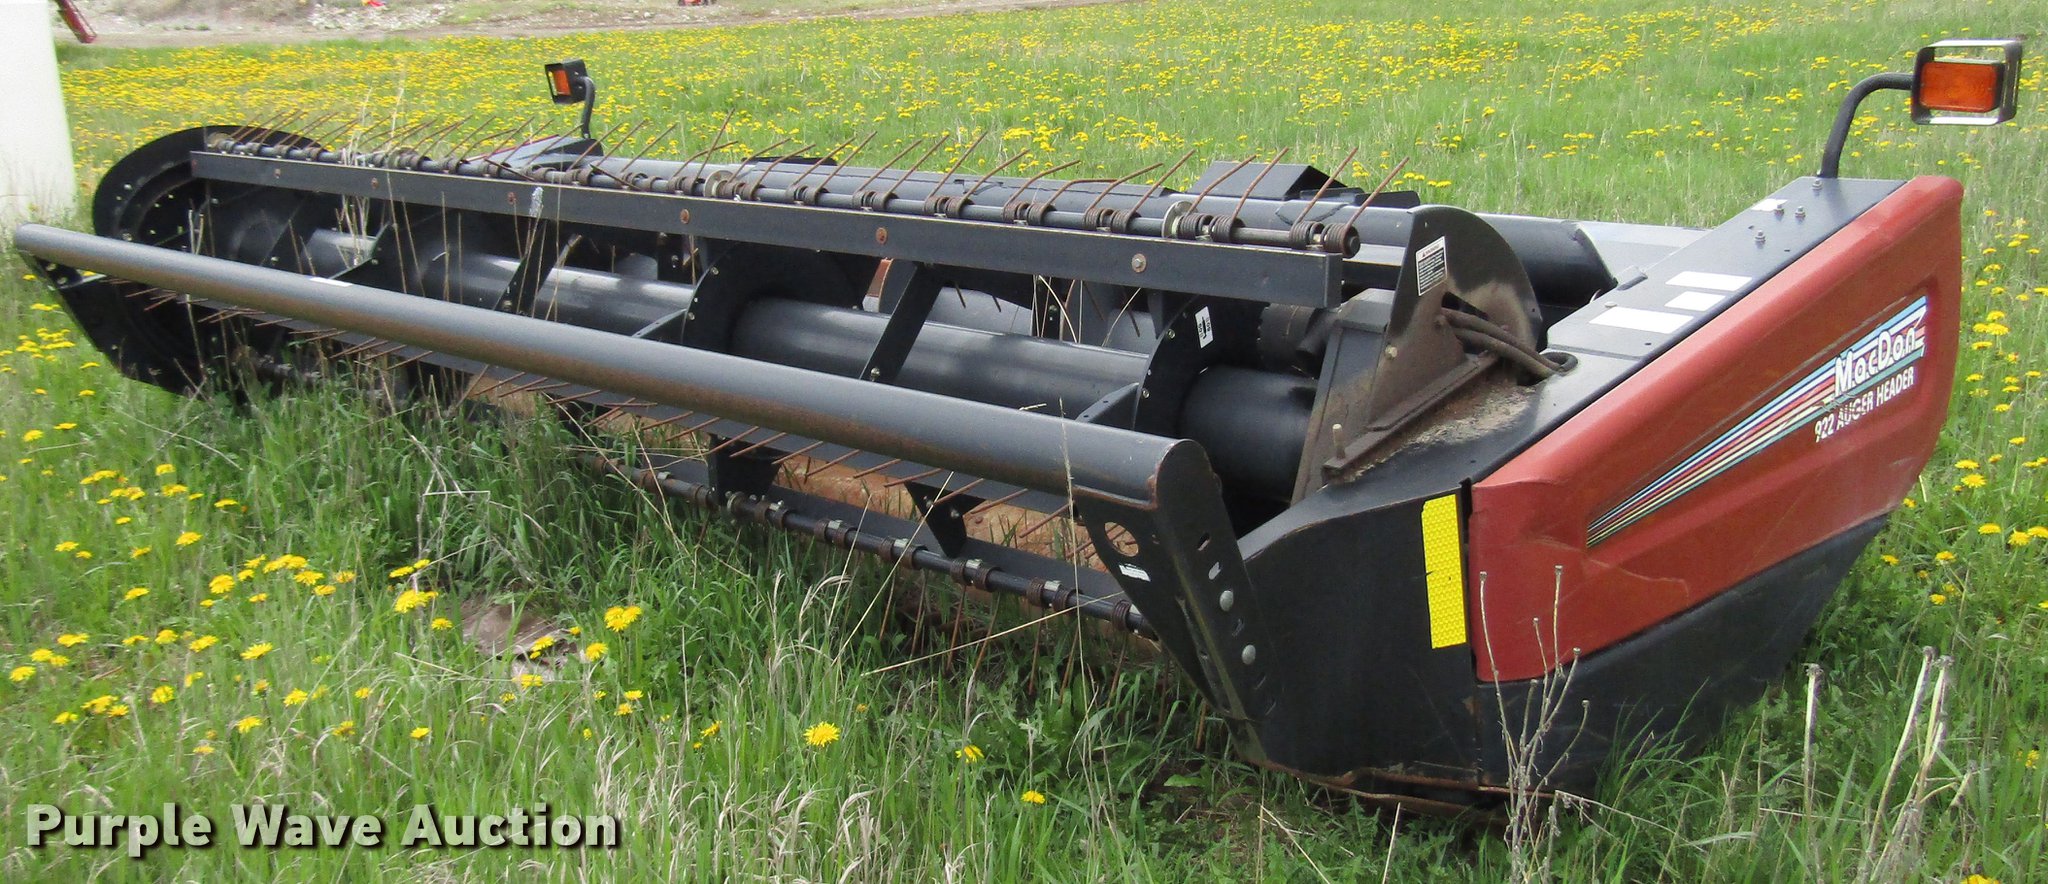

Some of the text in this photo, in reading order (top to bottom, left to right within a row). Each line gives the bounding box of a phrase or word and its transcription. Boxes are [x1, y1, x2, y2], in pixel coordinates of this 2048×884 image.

[1834, 328, 1916, 397] MacDon
[1815, 366, 1914, 443] 922 AUGER HEADER
